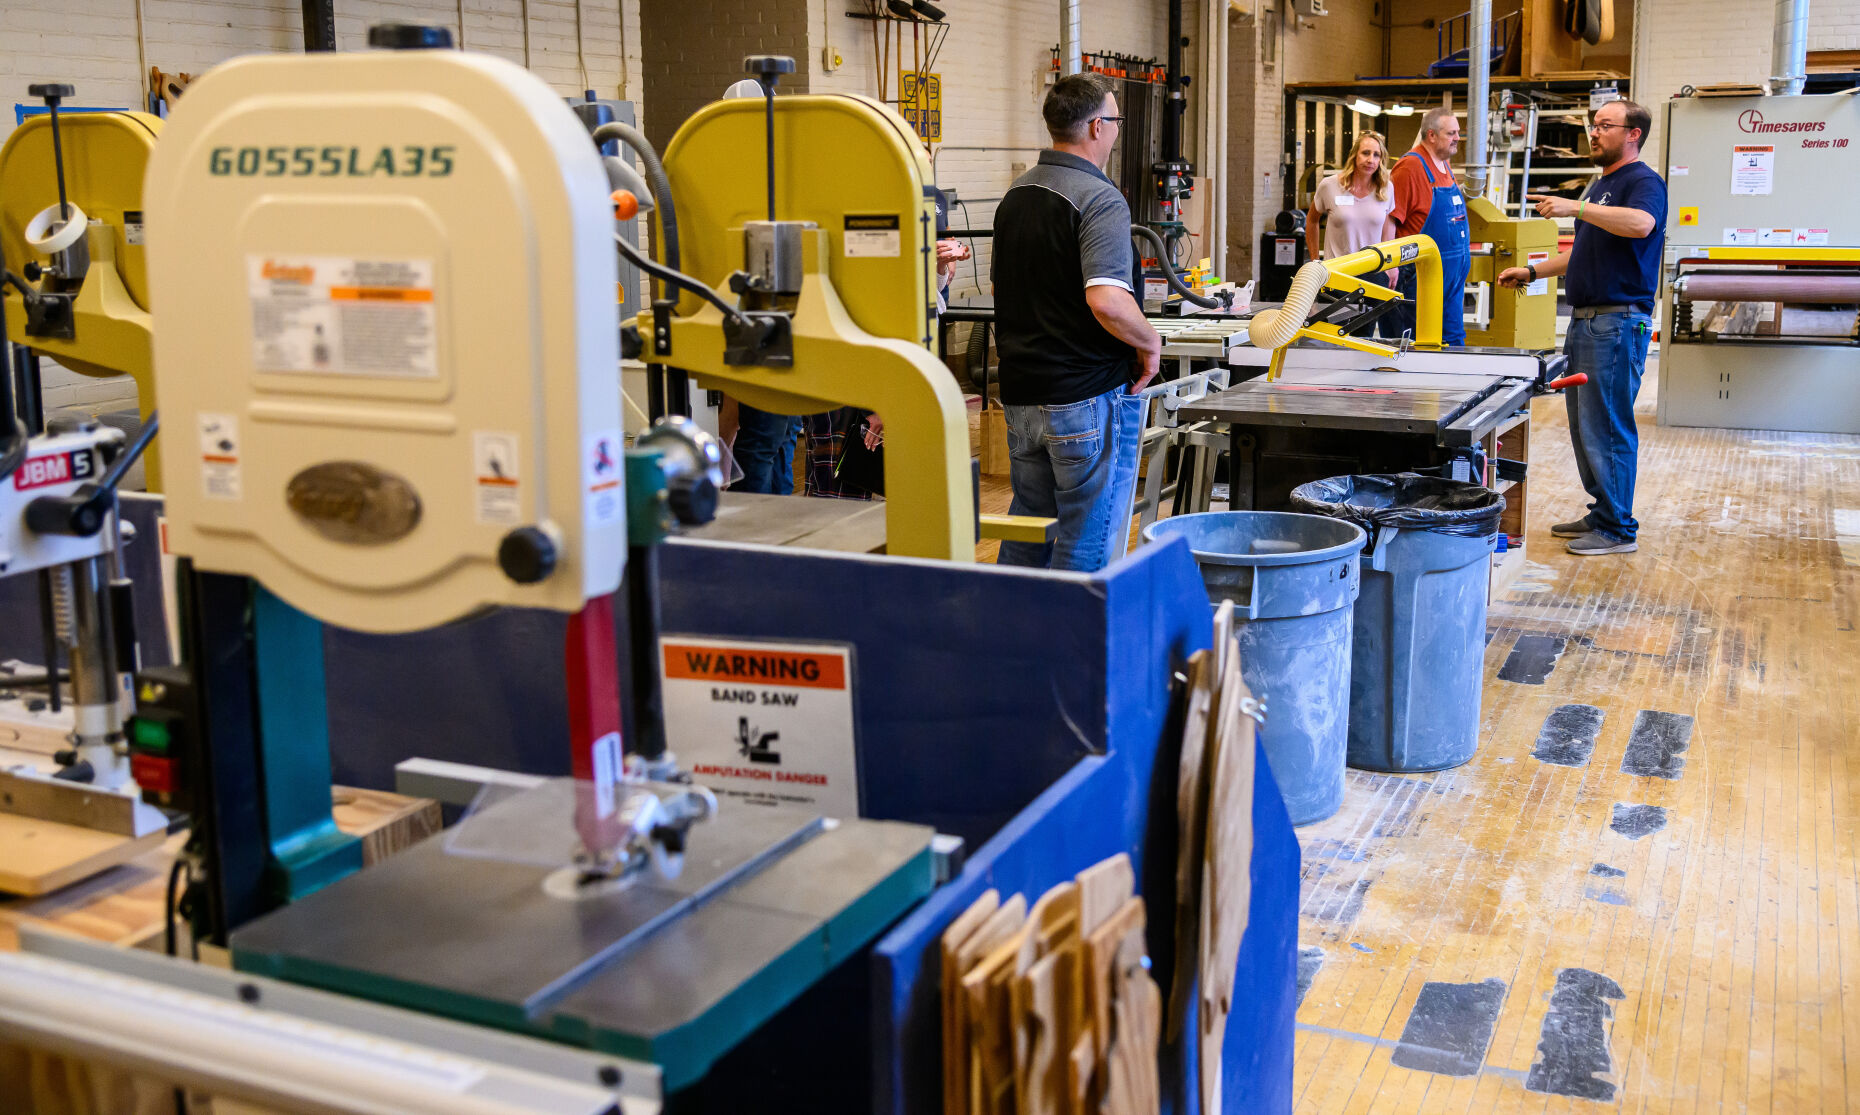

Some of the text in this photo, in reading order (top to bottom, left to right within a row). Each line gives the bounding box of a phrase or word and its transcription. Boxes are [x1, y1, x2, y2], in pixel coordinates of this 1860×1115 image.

[1751, 120, 1826, 133] Timesavers
[1801, 138, 1848, 148] Series 100
[18, 453, 91, 487] JBM 5
[686, 652, 820, 682] WARNING
[711, 688, 799, 707] BAND SAW
[693, 764, 828, 786] AMPUTATION DANGER
